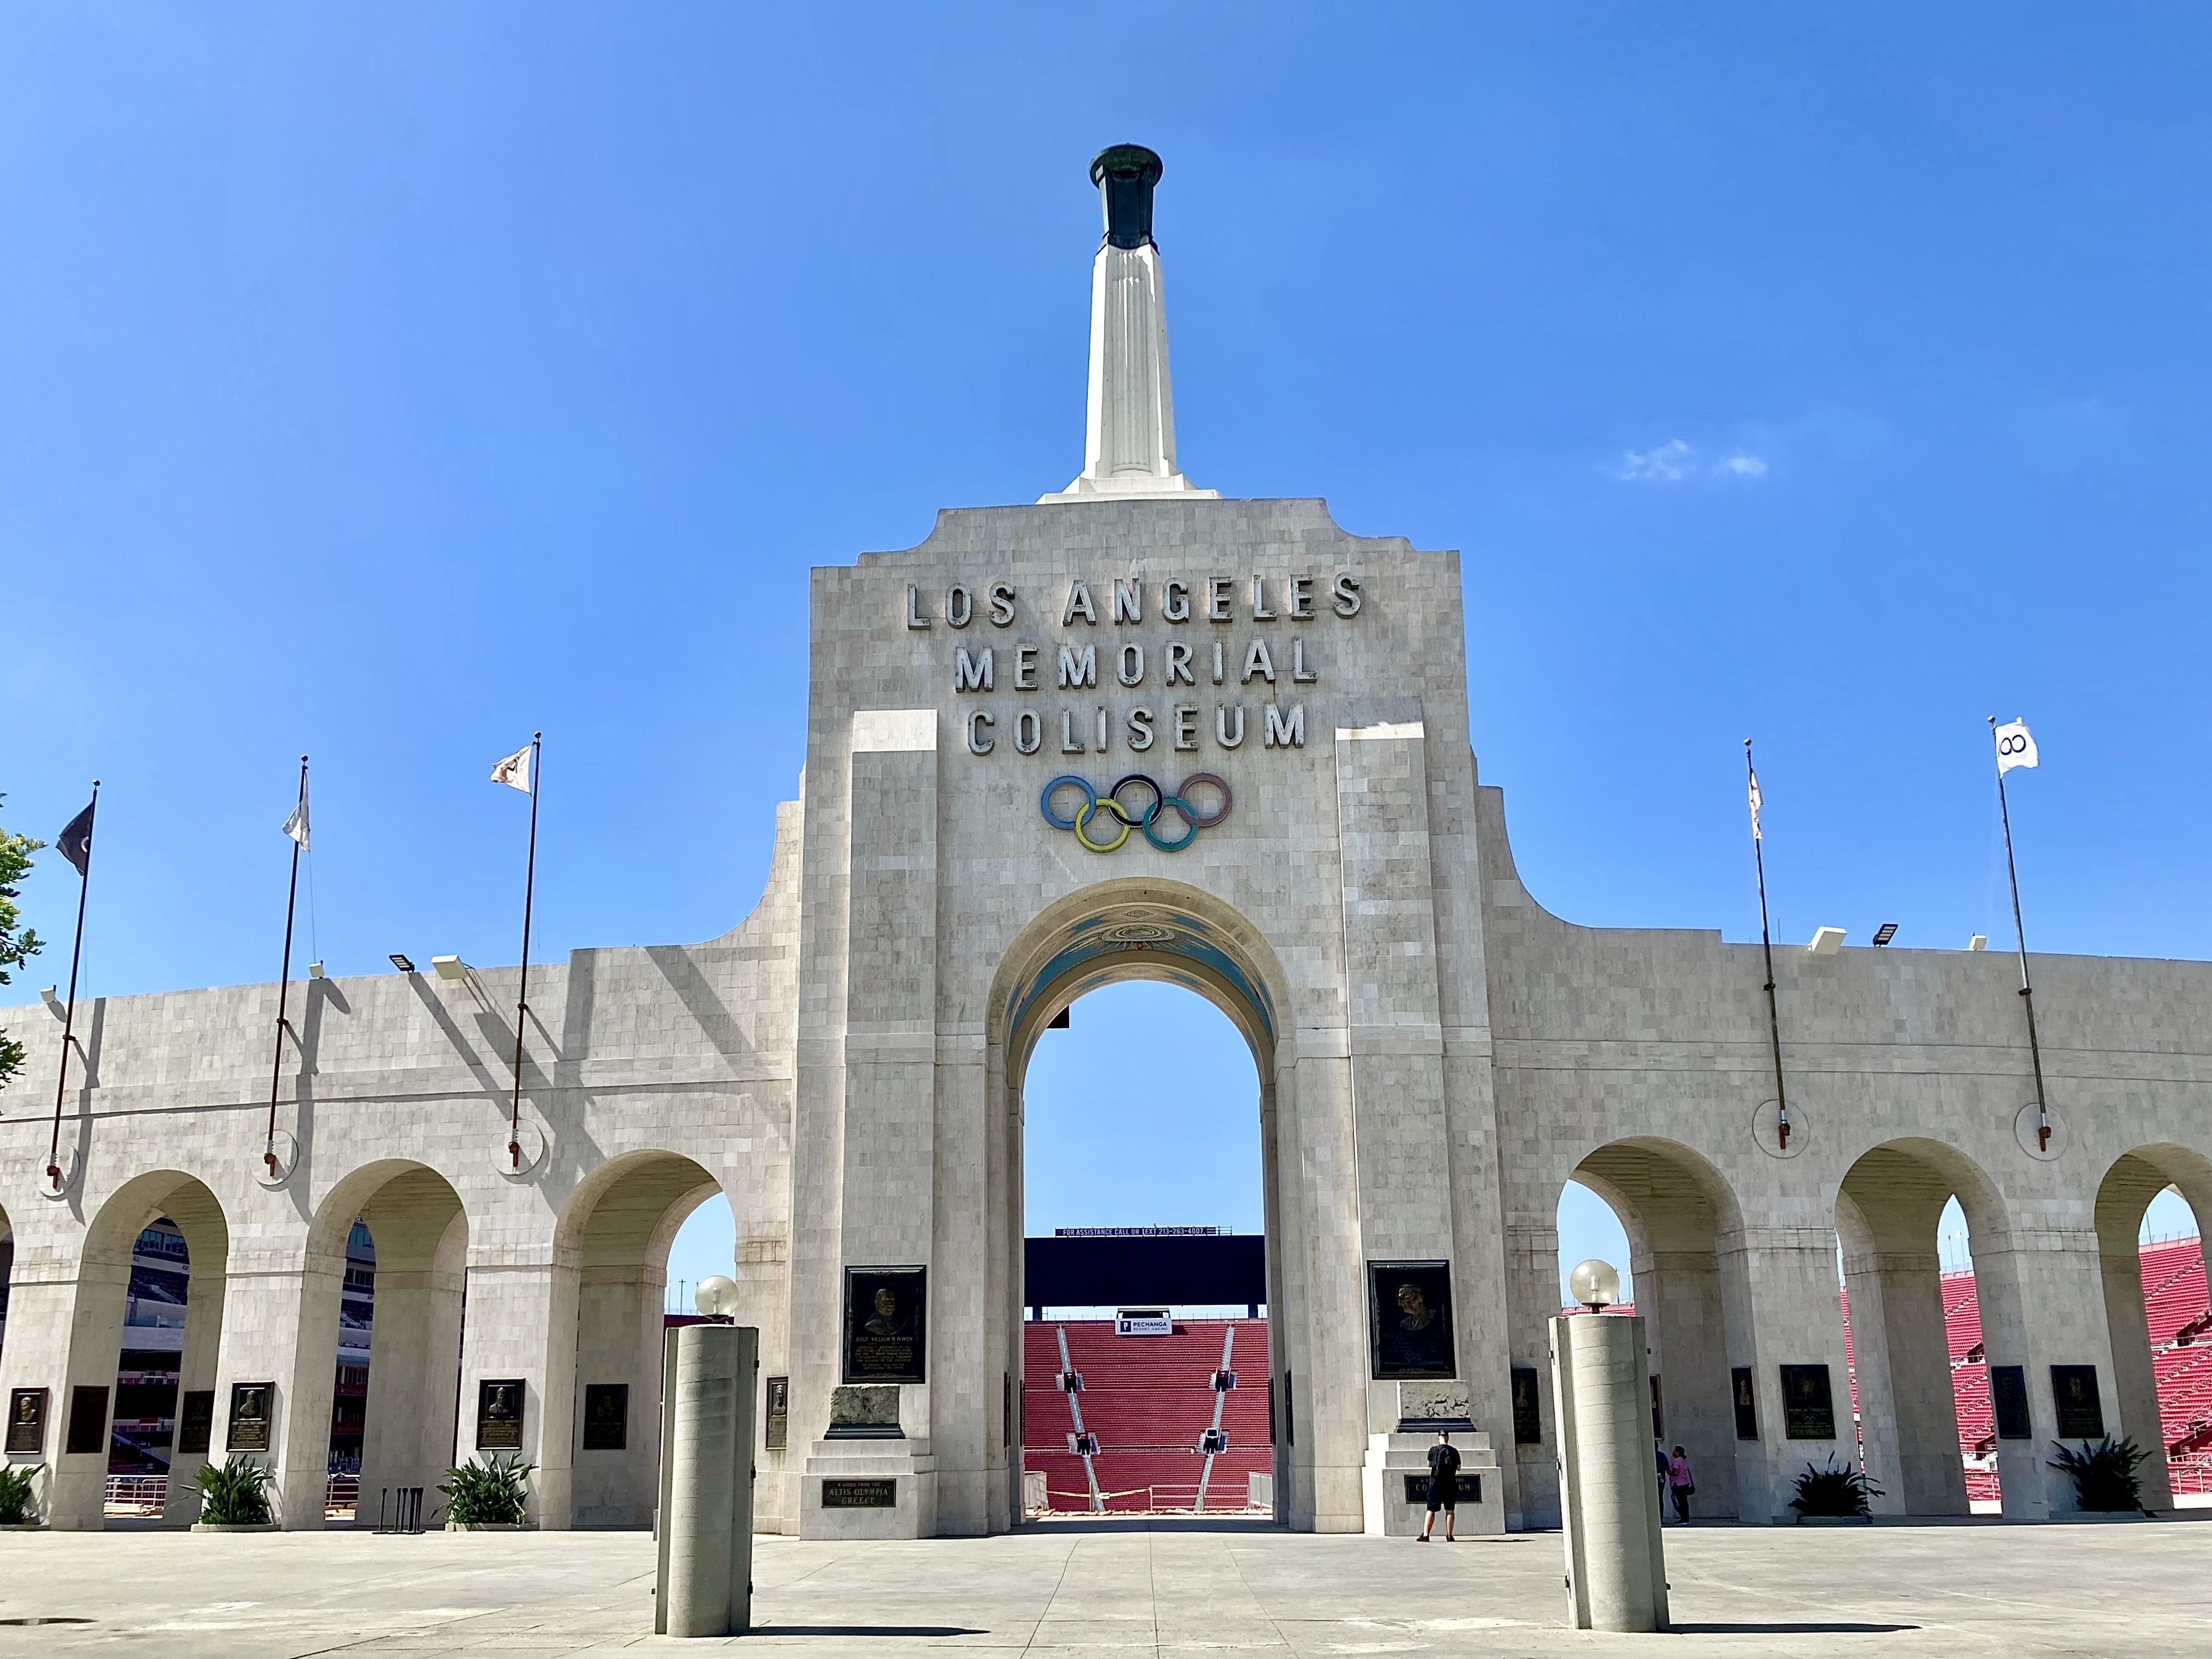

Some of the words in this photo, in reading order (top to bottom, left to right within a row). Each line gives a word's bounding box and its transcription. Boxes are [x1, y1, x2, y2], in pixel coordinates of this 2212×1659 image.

[907, 581, 1016, 630] LOS
[1062, 572, 1362, 625] ANGELES
[955, 636, 1318, 692] MEMORIAL
[968, 701, 1304, 756] COLISEUM
[855, 1488, 888, 1496] OLYMPIA
